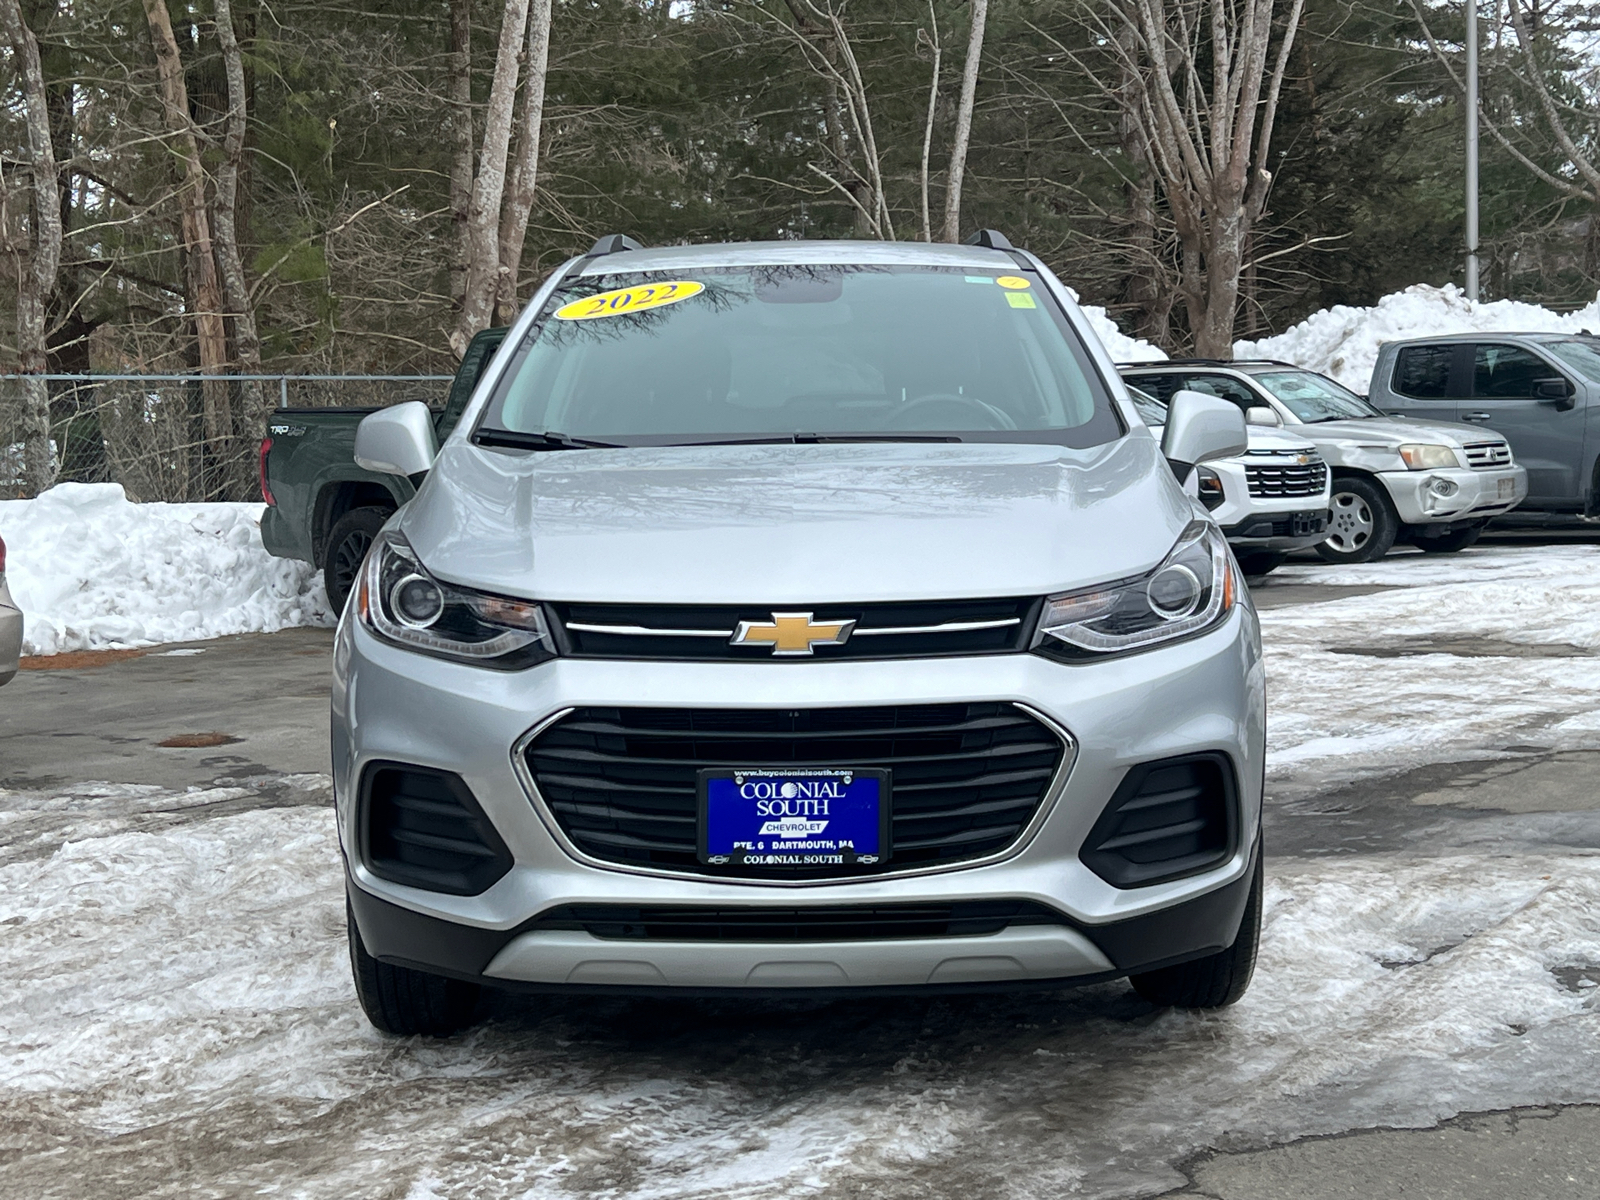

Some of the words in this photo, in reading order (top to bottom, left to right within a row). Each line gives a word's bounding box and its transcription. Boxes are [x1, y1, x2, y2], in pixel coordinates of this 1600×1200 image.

[585, 285, 678, 315] 2022
[270, 425, 289, 434] TRD
[734, 769, 853, 777] www.buycolonialsouth.com
[740, 782, 846, 799] COLONIAL
[757, 799, 830, 816] SOUTH
[766, 823, 821, 831] CHEVROLET
[757, 841, 764, 850] 6
[772, 840, 836, 850] DARTMOUTH,
[838, 840, 854, 849] MA
[743, 855, 802, 864] COLONIAL
[804, 855, 843, 864] SOUTH
